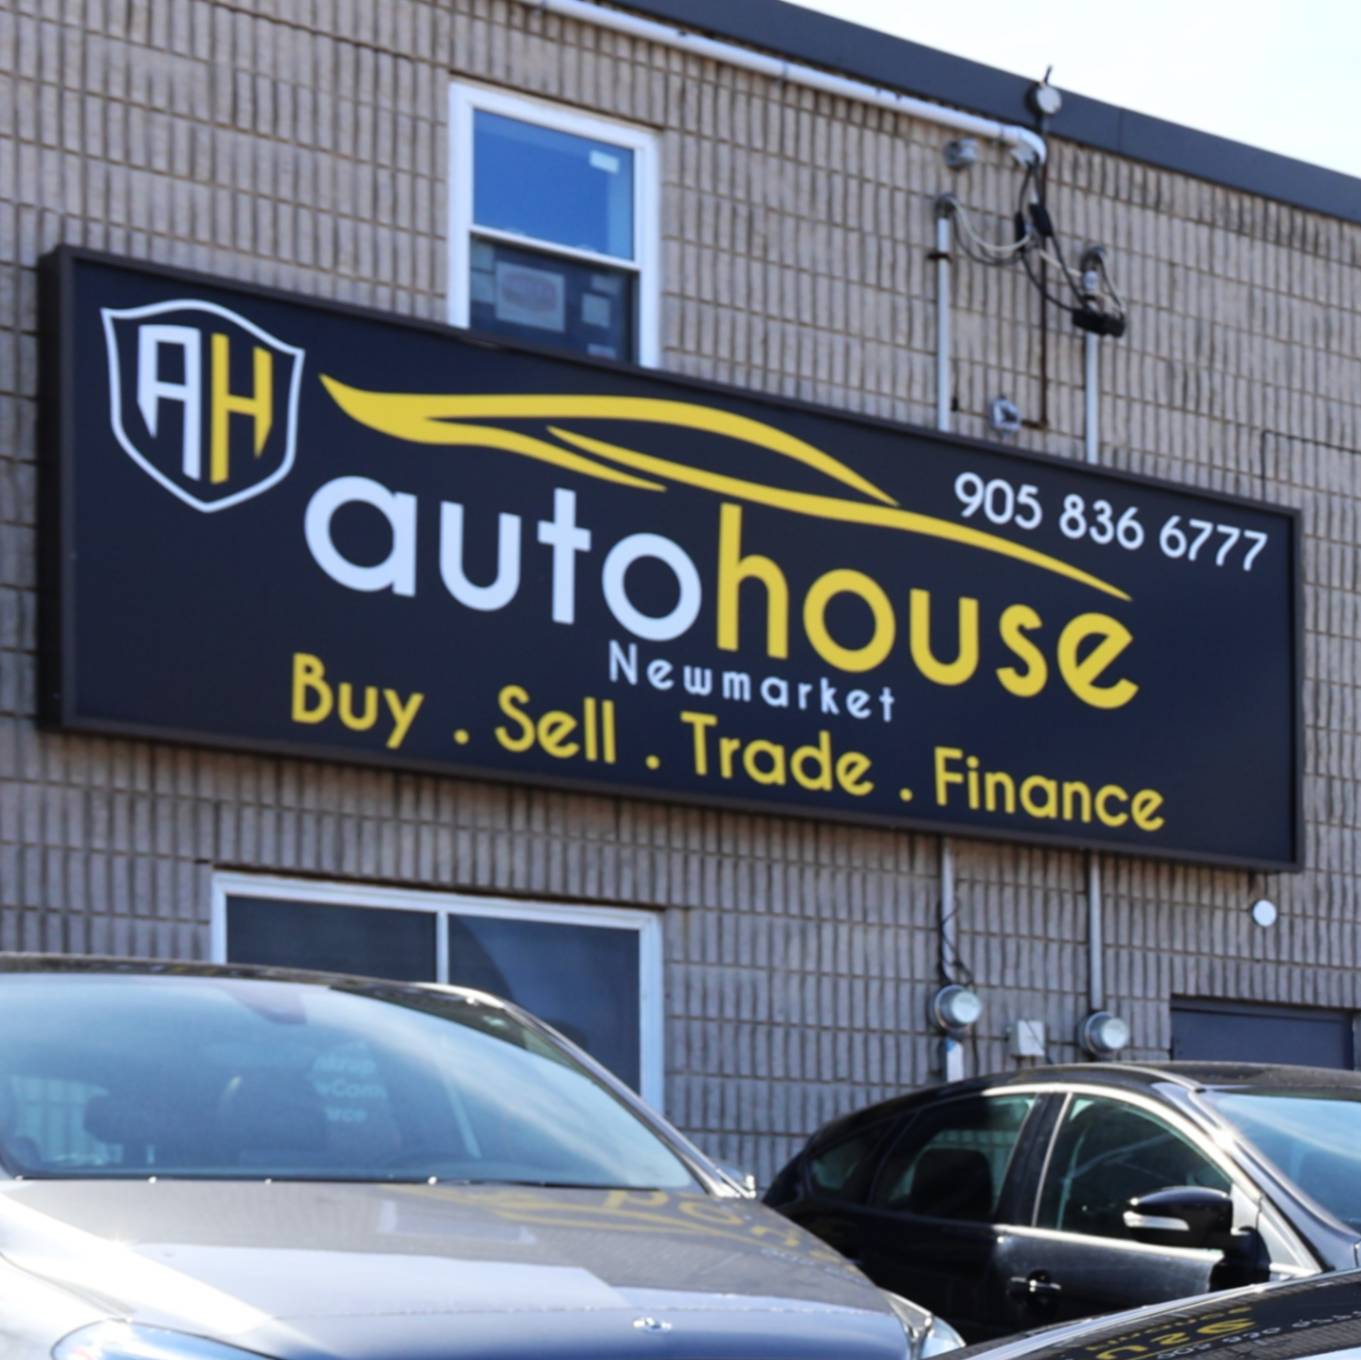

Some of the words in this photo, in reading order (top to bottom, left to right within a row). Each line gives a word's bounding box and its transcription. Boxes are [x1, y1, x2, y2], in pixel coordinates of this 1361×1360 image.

[136, 323, 273, 484] AH
[303, 475, 1138, 709] autohouse
[953, 471, 1042, 529] 905
[1058, 494, 1145, 551] 836
[1158, 514, 1269, 572] 6777
[292, 653, 424, 749] Buy
[495, 685, 616, 763] Sell
[680, 711, 874, 796] Trade
[934, 746, 1164, 831] Finance
[608, 639, 895, 723] Newmarket
